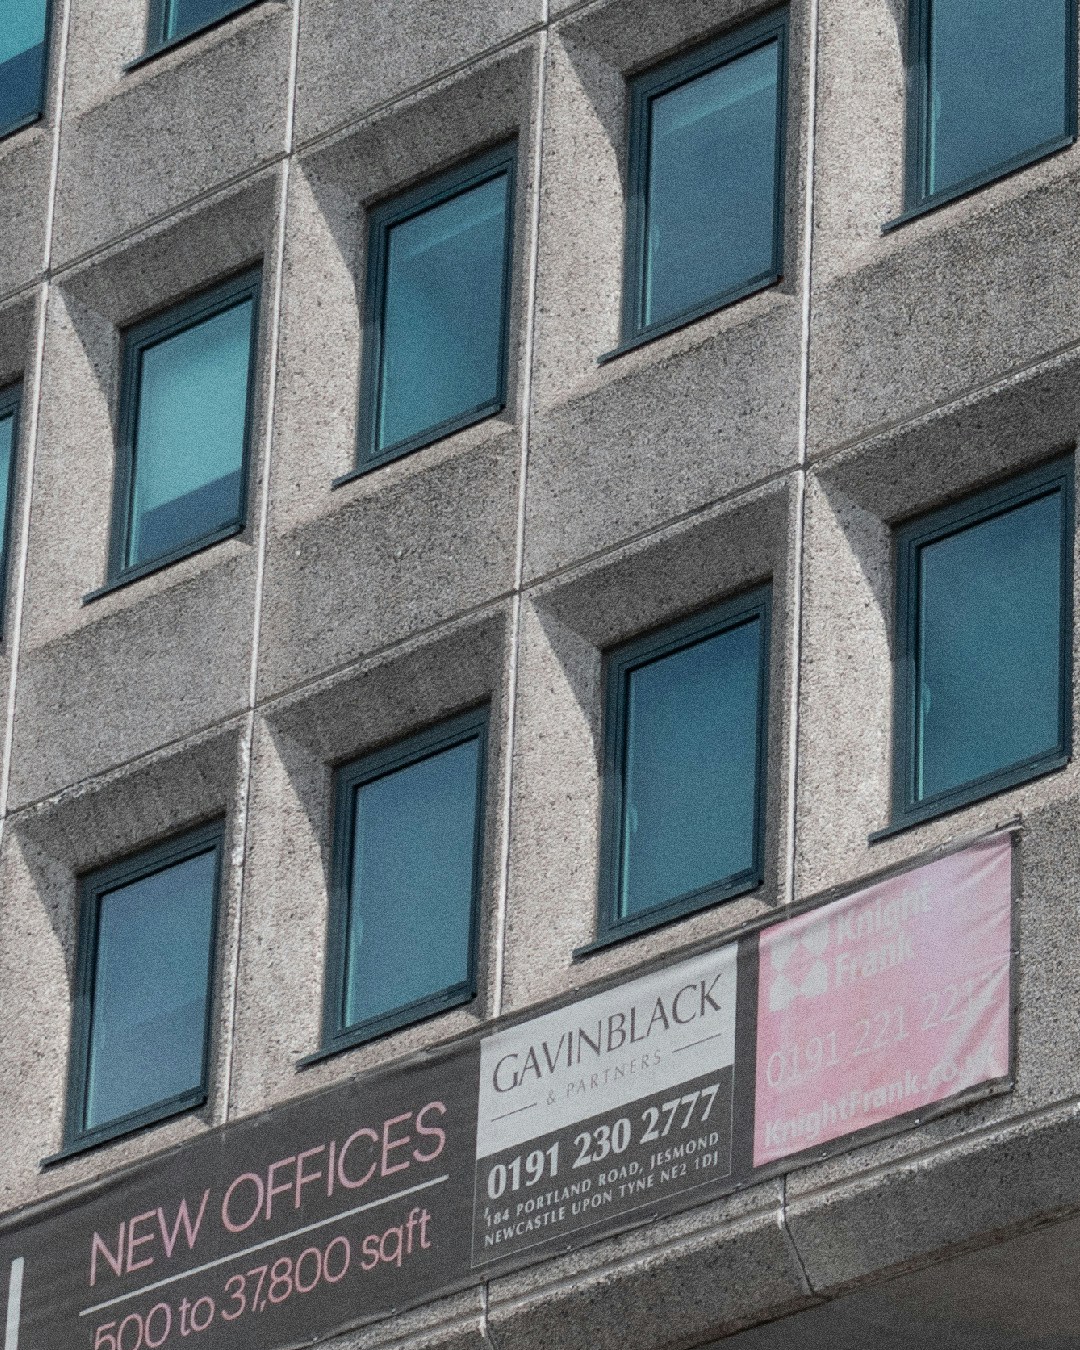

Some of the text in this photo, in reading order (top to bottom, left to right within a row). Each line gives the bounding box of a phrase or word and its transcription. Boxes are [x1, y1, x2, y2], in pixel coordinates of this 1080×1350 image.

[835, 930, 916, 987] Frank
[566, 1051, 662, 1096] PARTNERS
[767, 1030, 839, 1087] 0191
[853, 1006, 910, 1057] 221
[486, 1131, 719, 1228] 184 PORTLAND ROAD, JESMOND
[487, 1083, 720, 1200] 0191 230 2777
[89, 1101, 448, 1287] NEW OFFICES
[484, 1150, 719, 1248] NEWCASTLE UPON TYNE NE2 1DJ
[178, 1294, 216, 1338] to
[221, 1236, 351, 1321] 37,800
[360, 1206, 432, 1272] sqft
